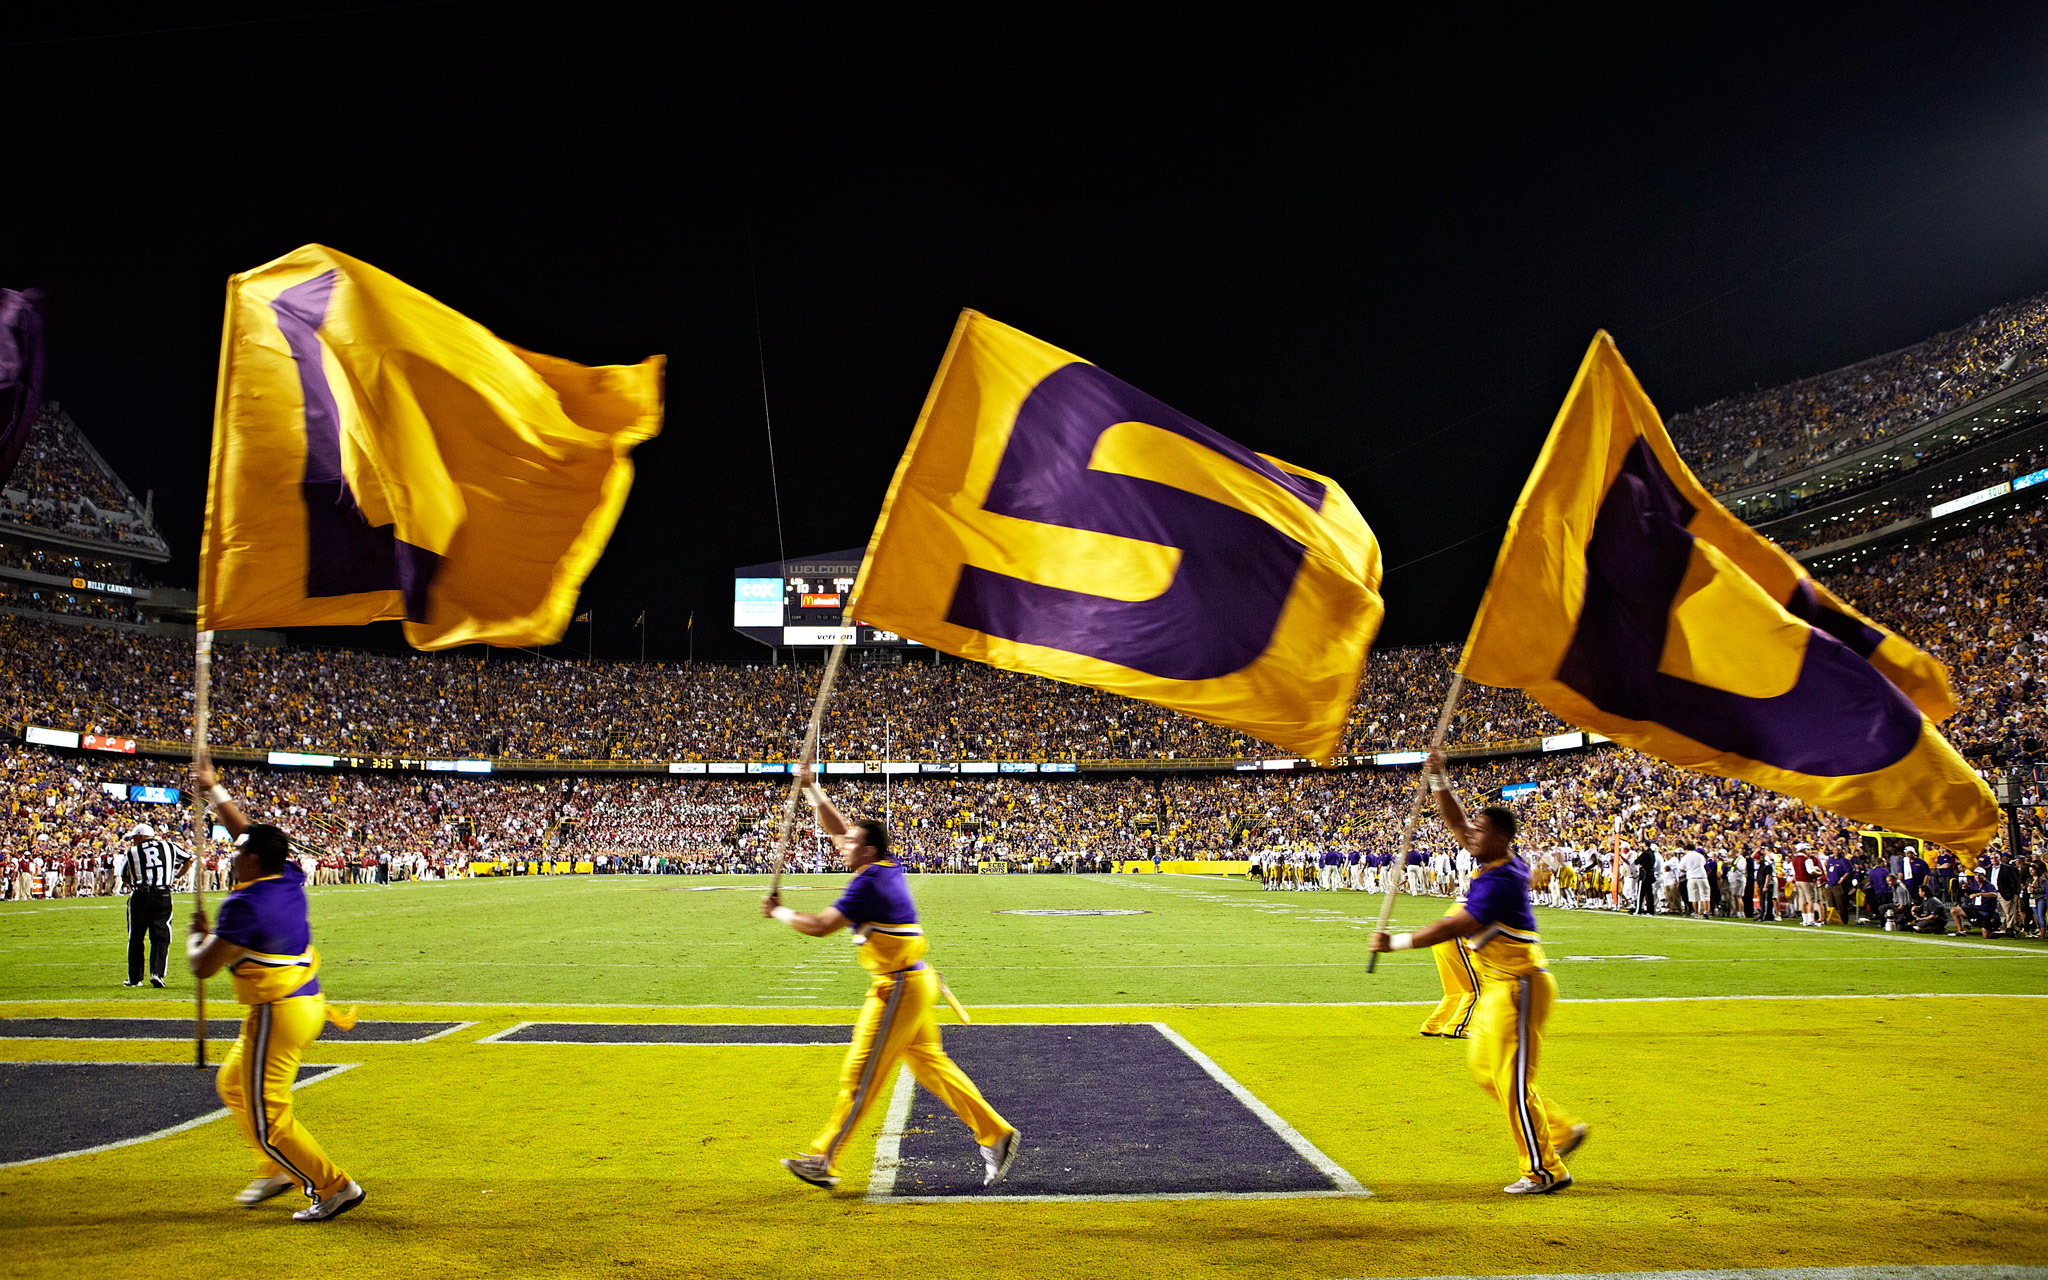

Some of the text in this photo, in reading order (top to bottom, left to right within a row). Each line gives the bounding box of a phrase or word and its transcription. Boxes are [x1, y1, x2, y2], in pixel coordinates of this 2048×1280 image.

[943, 362, 1327, 682] S
[789, 565, 858, 574] WELCOME
[87, 580, 106, 591] BILLY
[106, 583, 133, 595] CANNON
[817, 632, 853, 641] verion
[372, 758, 394, 769] 3:35
[1330, 756, 1349, 766] 3:35
[144, 847, 163, 867] R
[980, 867, 1005, 875] SPORTS
